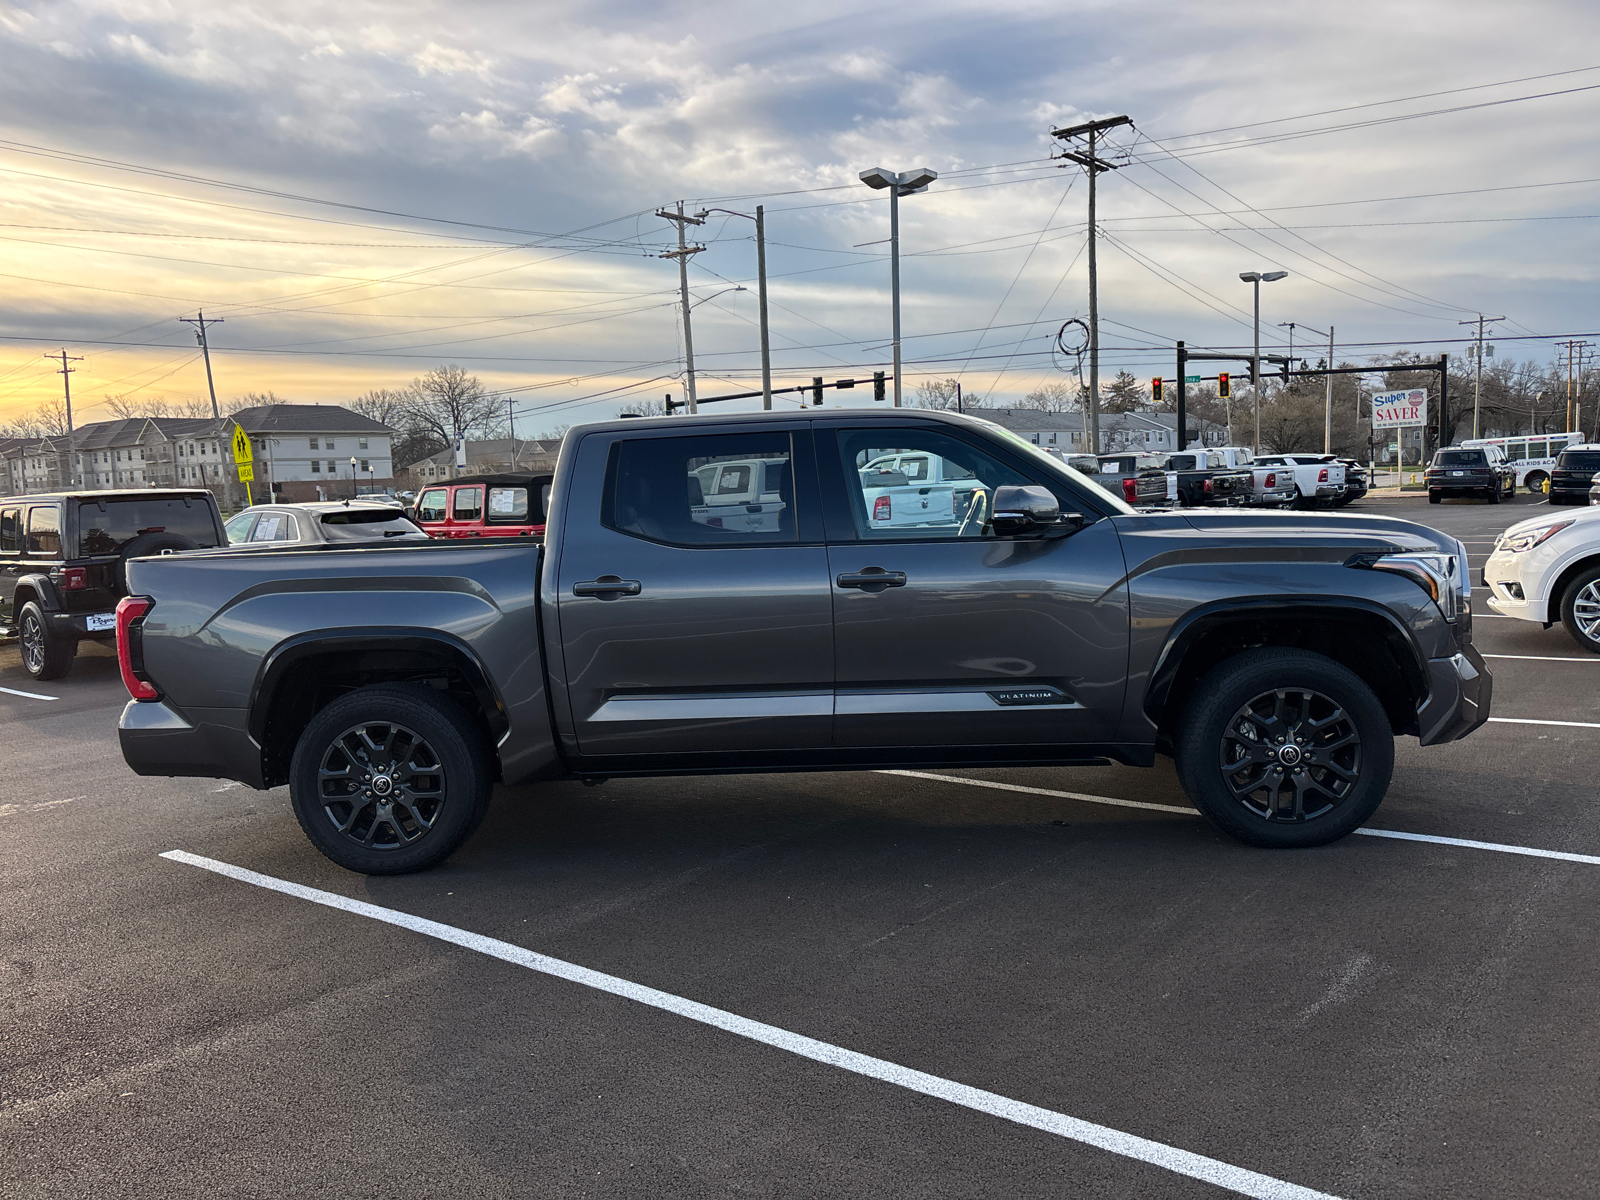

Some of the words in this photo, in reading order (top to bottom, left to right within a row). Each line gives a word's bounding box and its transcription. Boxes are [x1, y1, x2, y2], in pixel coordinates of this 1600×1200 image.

[1374, 392, 1406, 407] Super
[1376, 407, 1419, 422] SAVER
[240, 468, 252, 478] AHEAD
